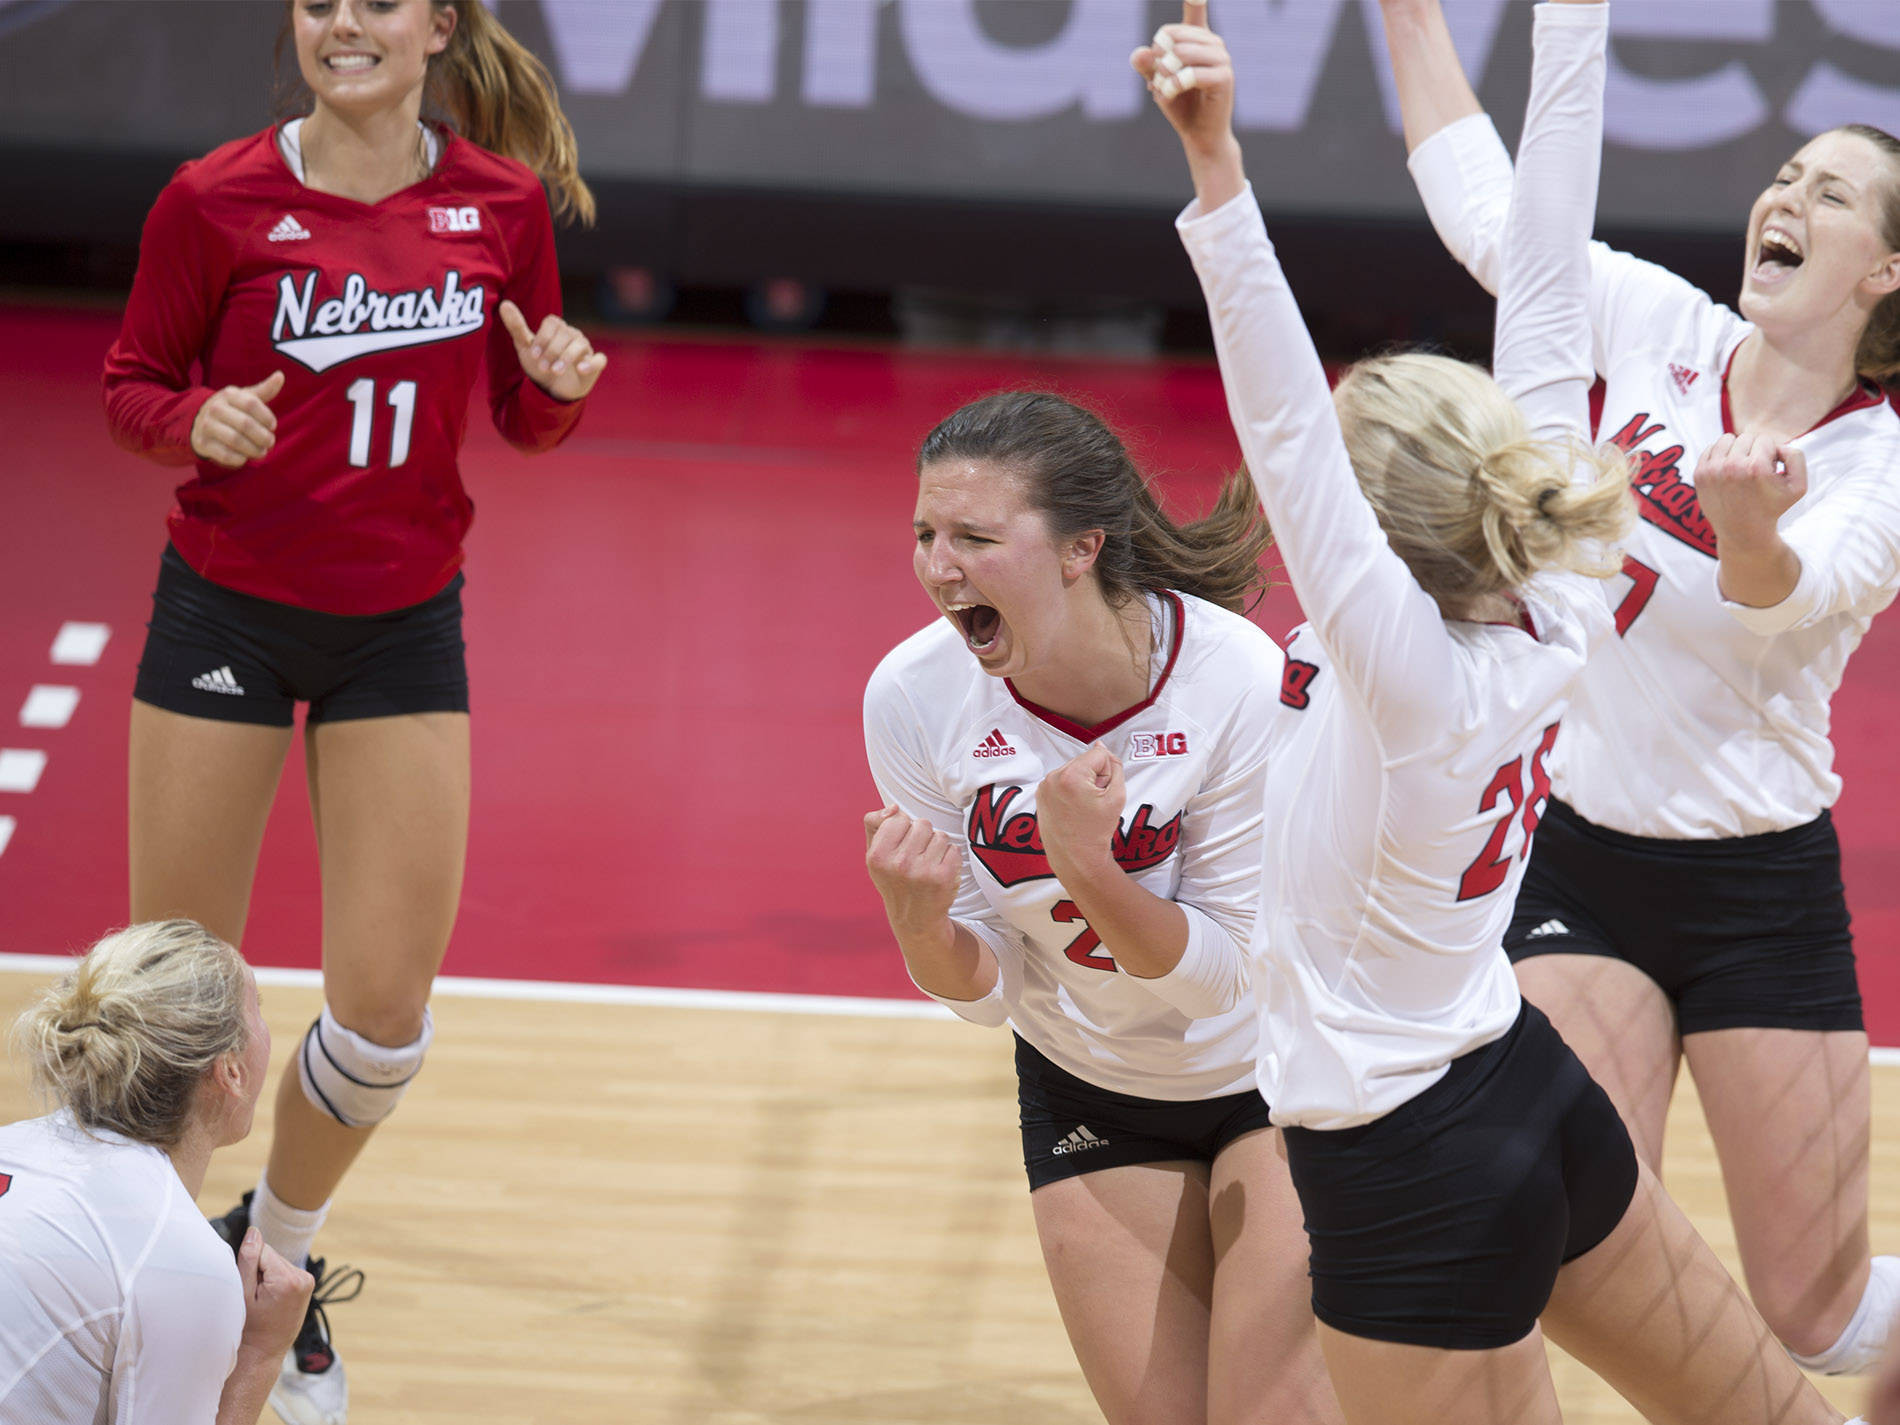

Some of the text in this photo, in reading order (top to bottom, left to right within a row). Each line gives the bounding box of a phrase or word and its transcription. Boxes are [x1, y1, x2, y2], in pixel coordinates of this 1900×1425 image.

[270, 267, 486, 342] Nebraska
[346, 377, 418, 468] 11
[972, 745, 1016, 758] adidas
[1050, 899, 1119, 973] 2
